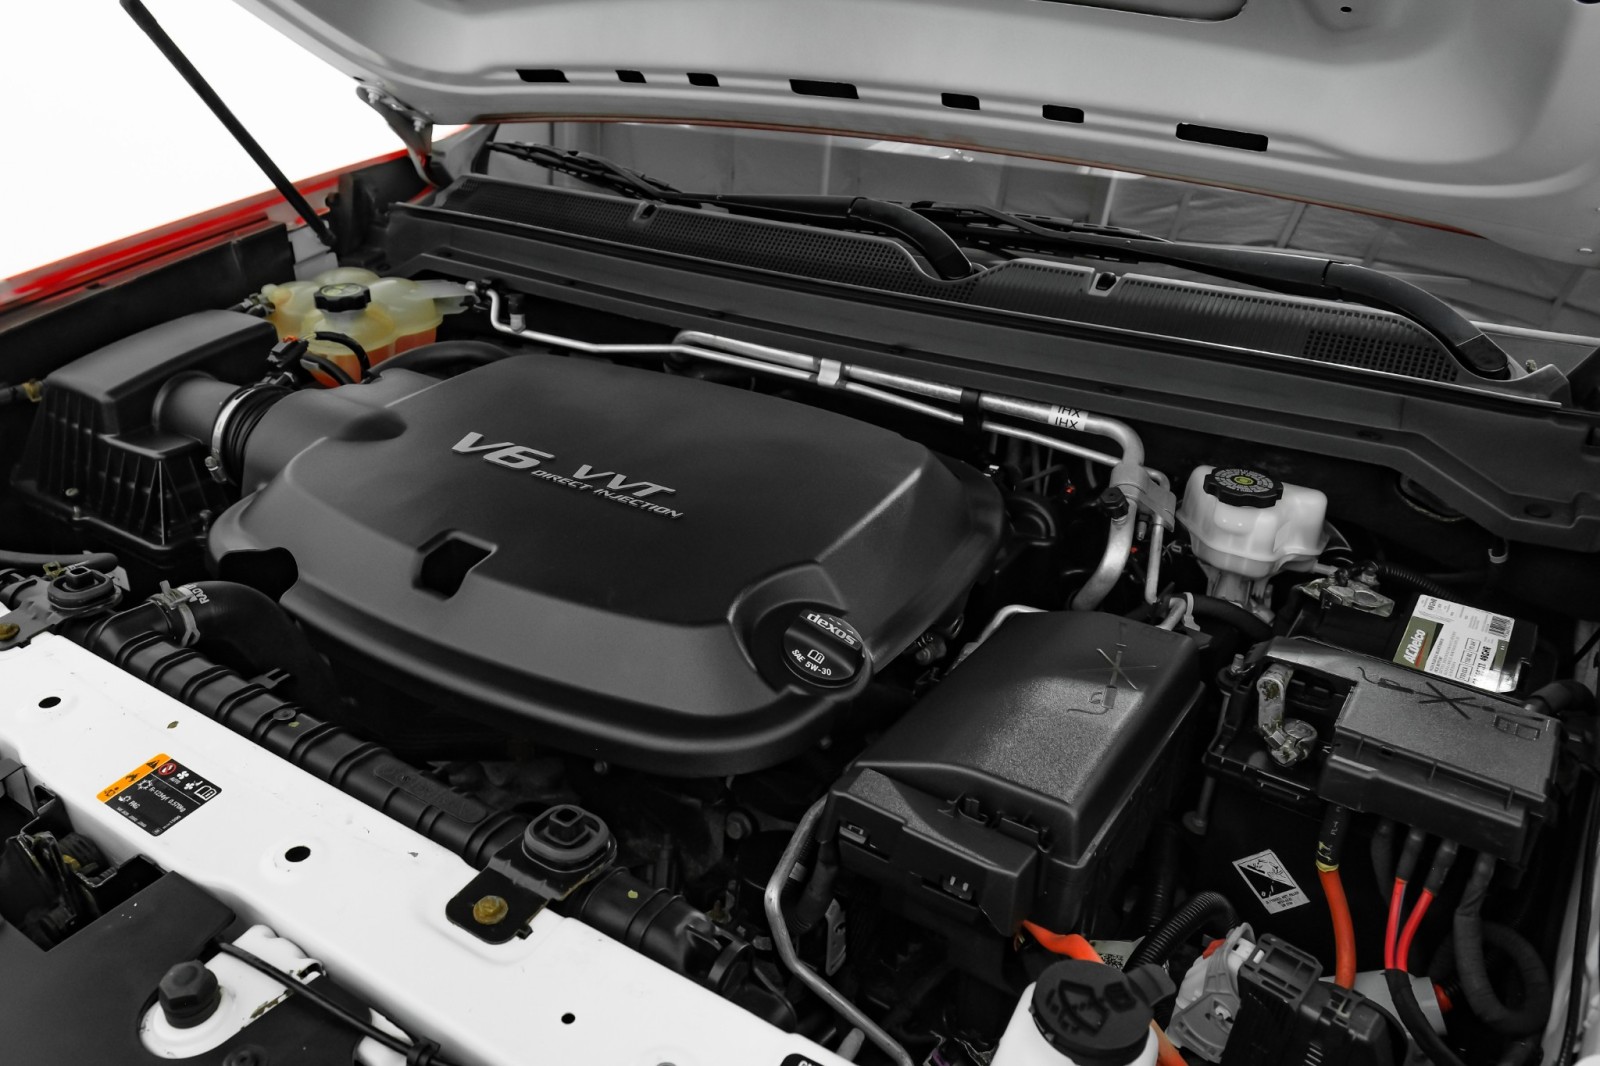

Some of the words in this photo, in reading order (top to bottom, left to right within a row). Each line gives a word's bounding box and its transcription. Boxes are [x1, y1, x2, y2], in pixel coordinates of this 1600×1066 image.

[1055, 416, 1078, 430] IHX
[452, 431, 555, 469] V6
[572, 464, 676, 497] VVT
[531, 469, 594, 490] DIRECT
[593, 488, 683, 519] INJECTION
[806, 613, 857, 646] dexos
[1403, 629, 1426, 664] ACDelco
[791, 649, 806, 663] SAE
[805, 661, 832, 676] 5W-30
